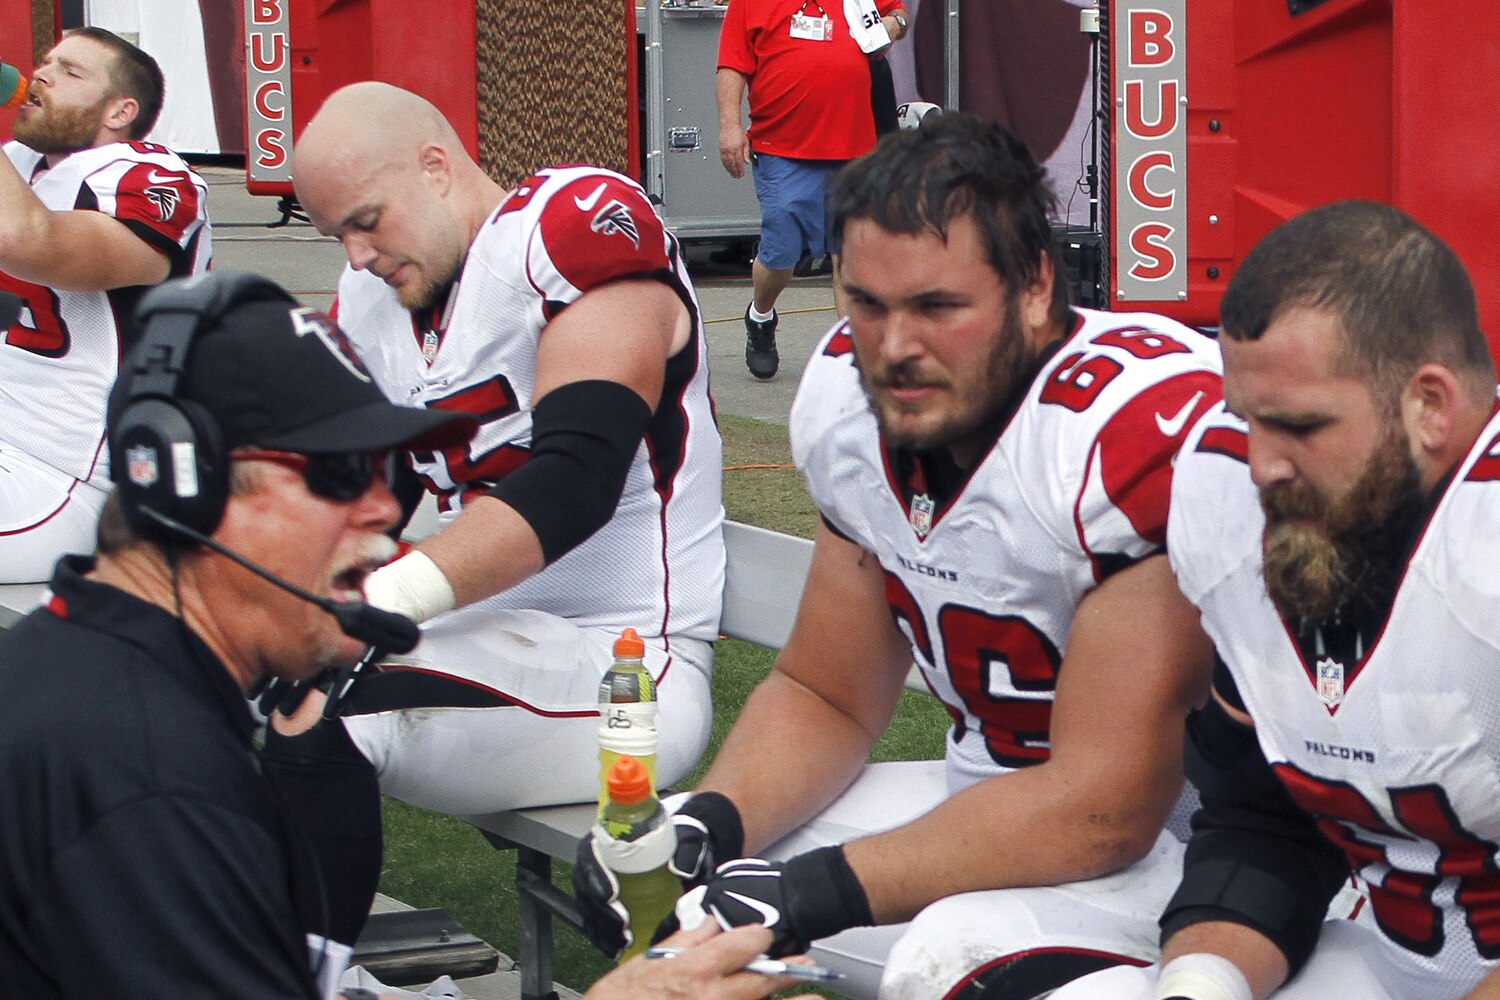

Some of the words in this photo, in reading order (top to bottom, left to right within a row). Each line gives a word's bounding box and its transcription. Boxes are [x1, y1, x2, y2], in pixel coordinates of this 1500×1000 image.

[250, 0, 287, 169] BUCS
[1124, 9, 1178, 282] BUCS
[896, 553, 958, 581] ALCONS
[1305, 740, 1375, 763] FALCONS
